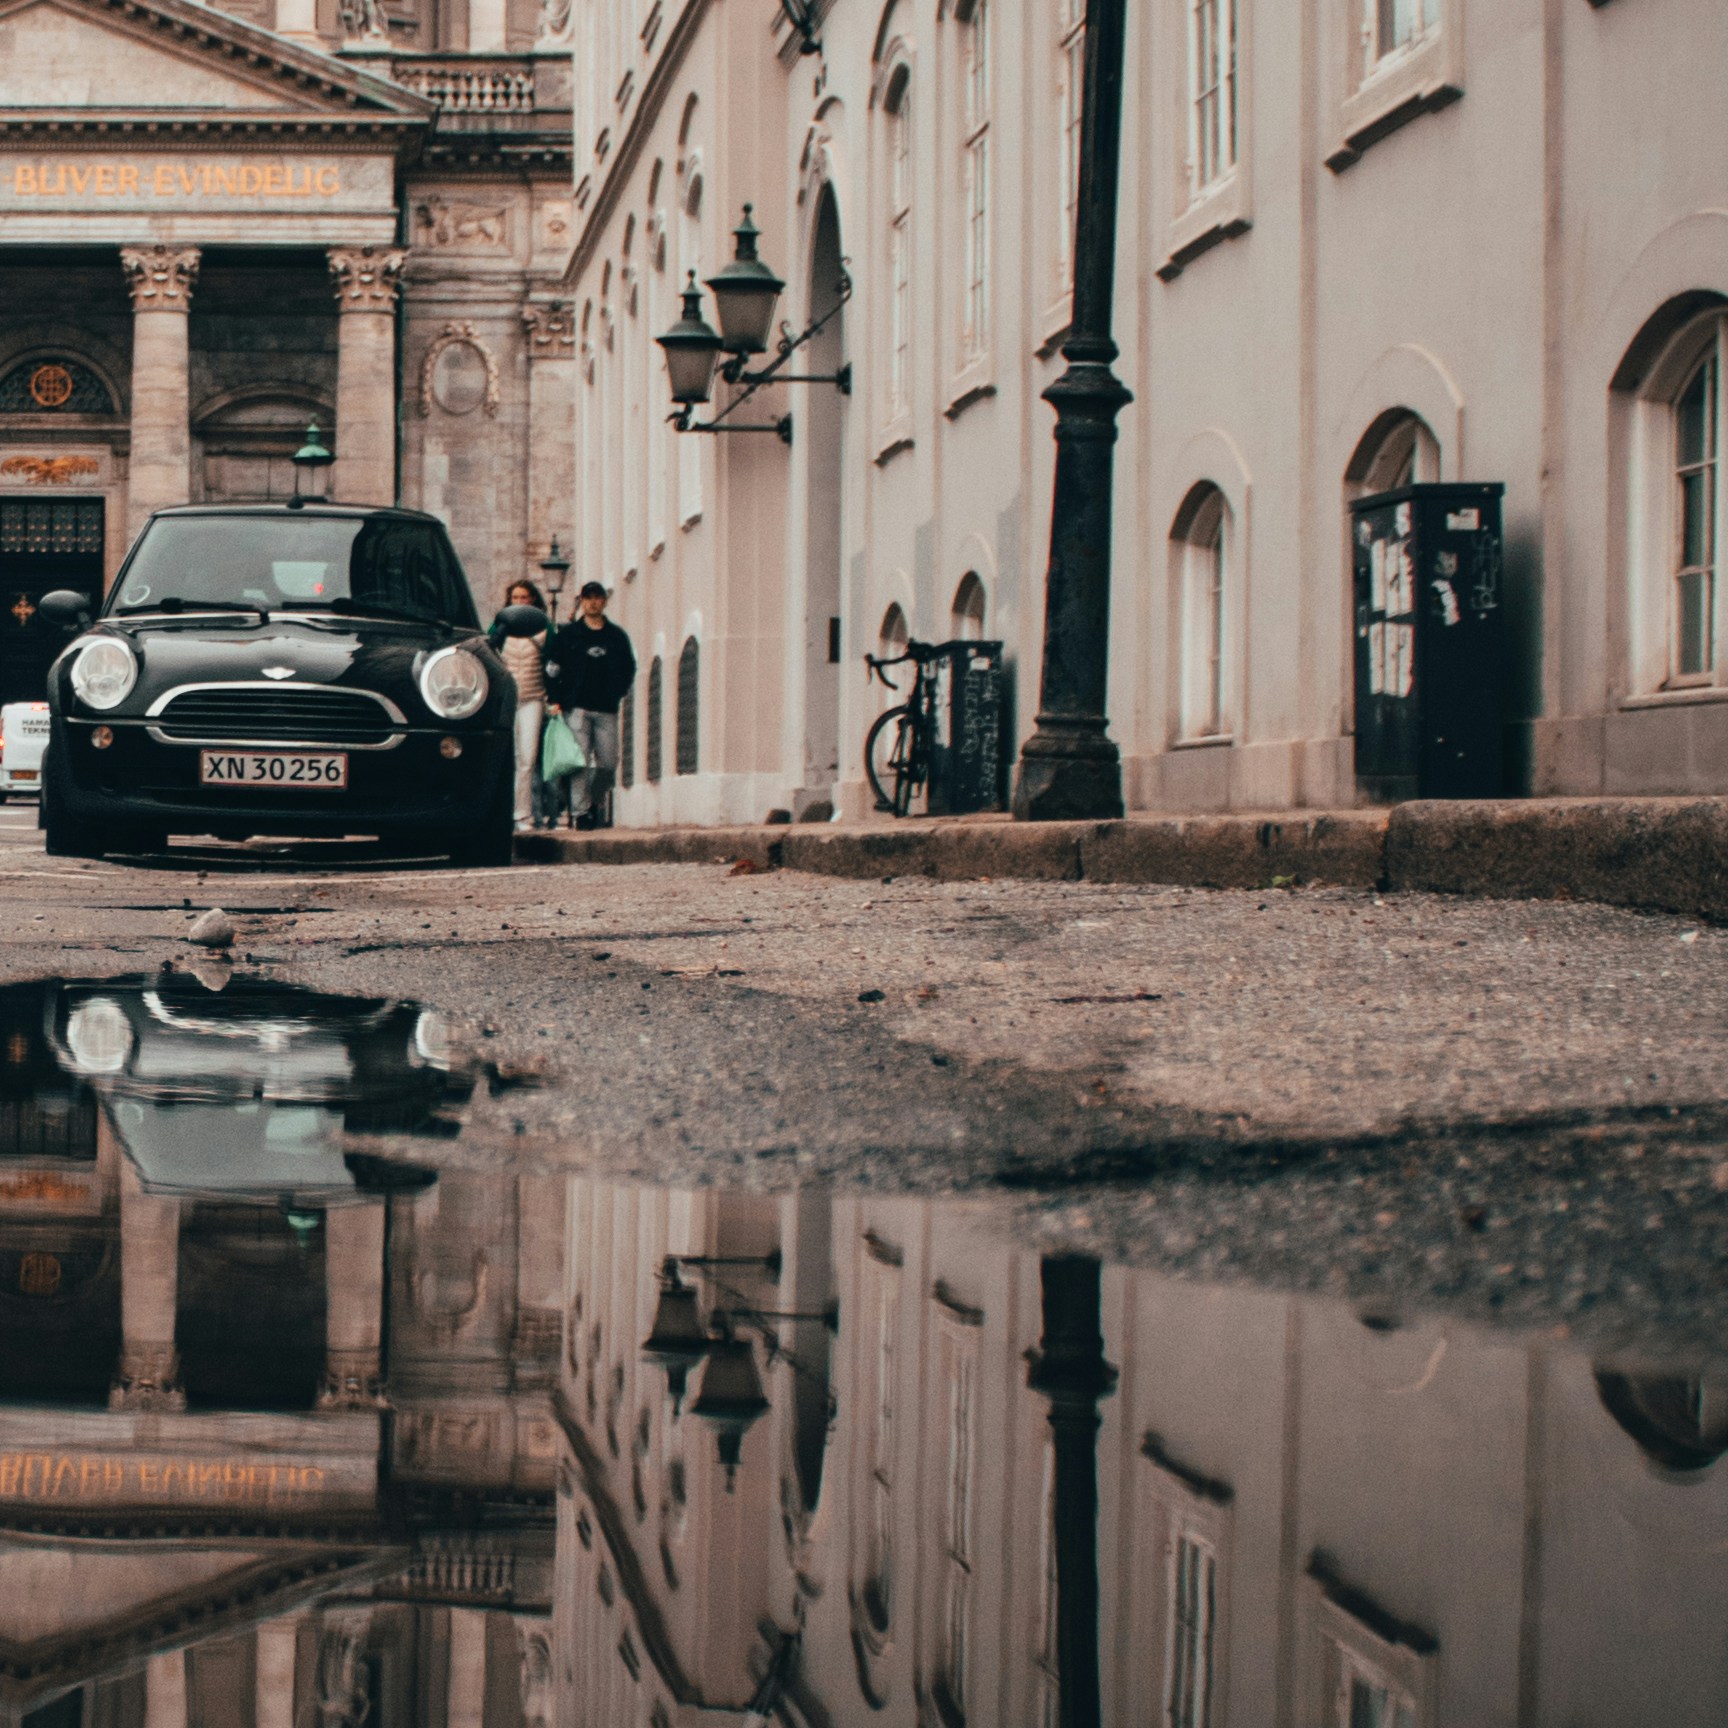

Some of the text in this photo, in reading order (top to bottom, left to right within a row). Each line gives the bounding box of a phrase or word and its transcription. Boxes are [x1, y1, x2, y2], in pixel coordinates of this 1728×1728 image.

[14, 164, 140, 196] BLIVER
[154, 164, 341, 197] EVINDELIG
[207, 756, 245, 779] XN
